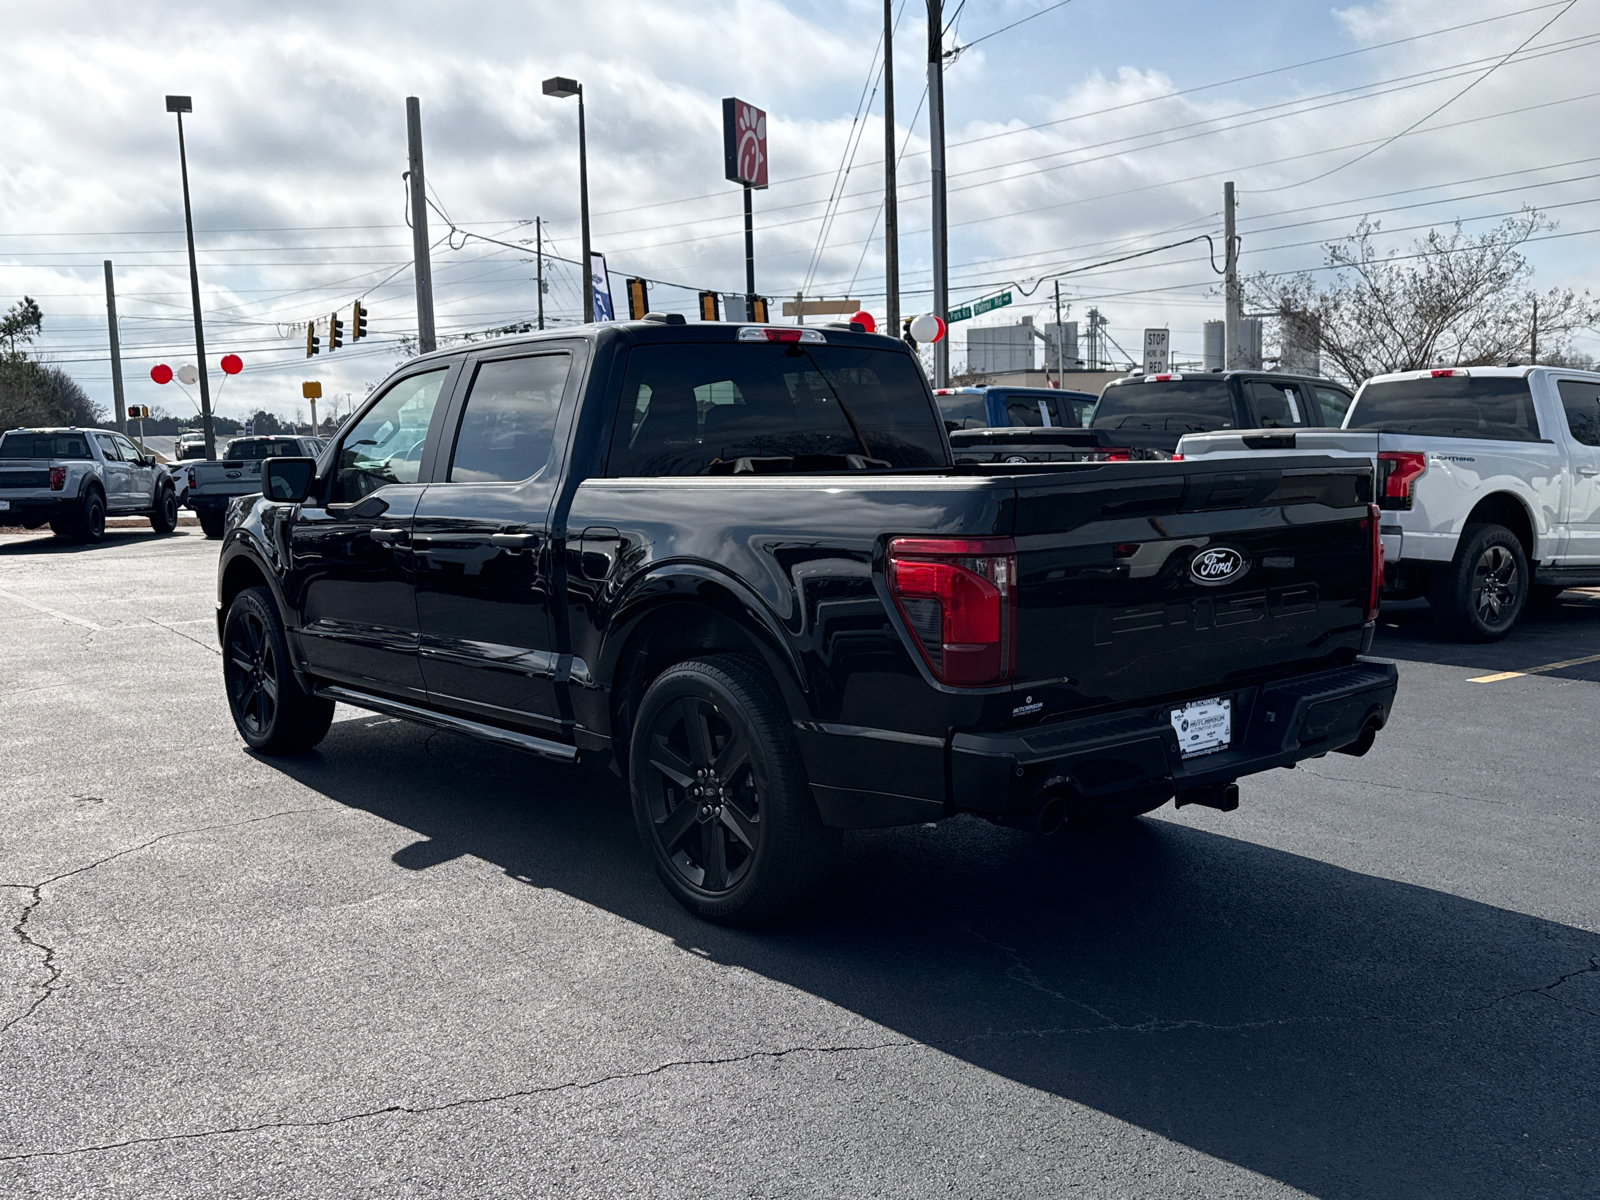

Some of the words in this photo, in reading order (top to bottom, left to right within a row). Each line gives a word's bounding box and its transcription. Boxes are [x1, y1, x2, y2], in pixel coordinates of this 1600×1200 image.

[975, 301, 992, 314] Patrol
[994, 297, 1002, 307] Rd
[950, 310, 962, 320] Park
[962, 308, 970, 318] Rd
[1148, 333, 1166, 346] STOP
[1149, 362, 1162, 373] RED
[1199, 552, 1235, 577] Ford
[1094, 581, 1320, 647] F-150
[1190, 714, 1226, 728] HUTCHINSON
